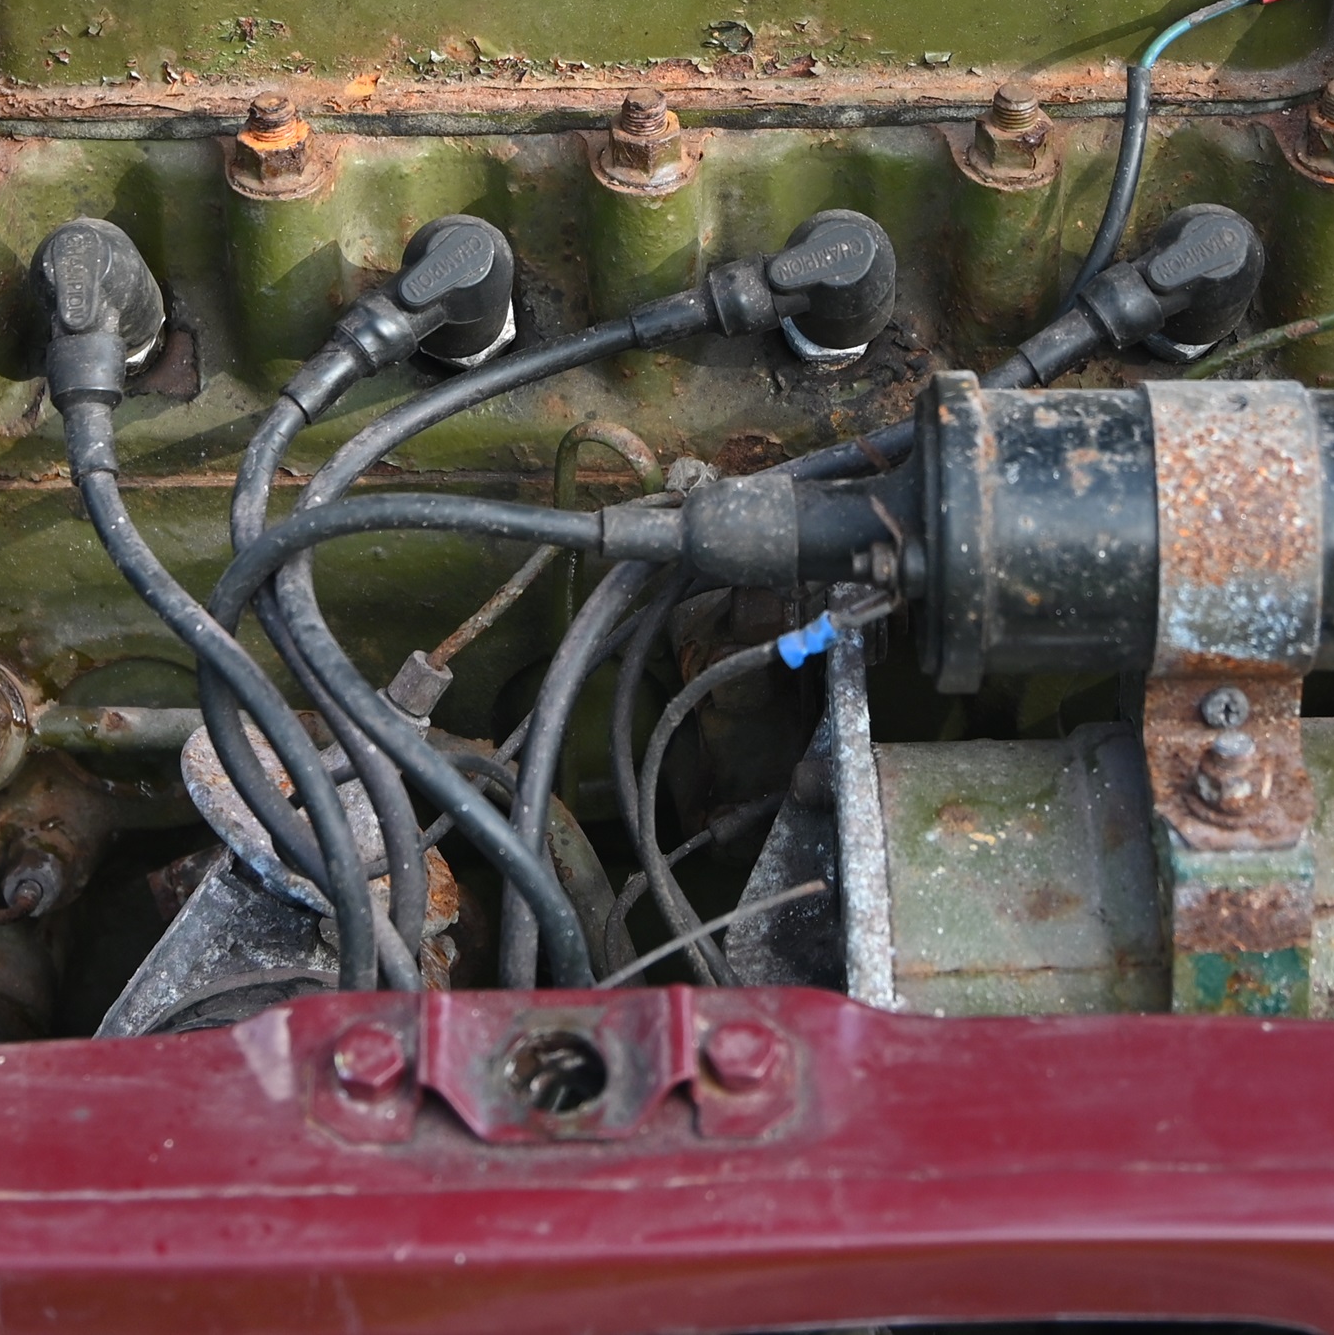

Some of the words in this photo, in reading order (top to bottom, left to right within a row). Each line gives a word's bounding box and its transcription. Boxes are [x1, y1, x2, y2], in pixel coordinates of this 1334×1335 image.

[66, 234, 85, 321] CHAMPION
[407, 234, 483, 298] CHAMPION
[777, 238, 864, 282] CHAMPION
[1155, 228, 1240, 281] CHAMPION
